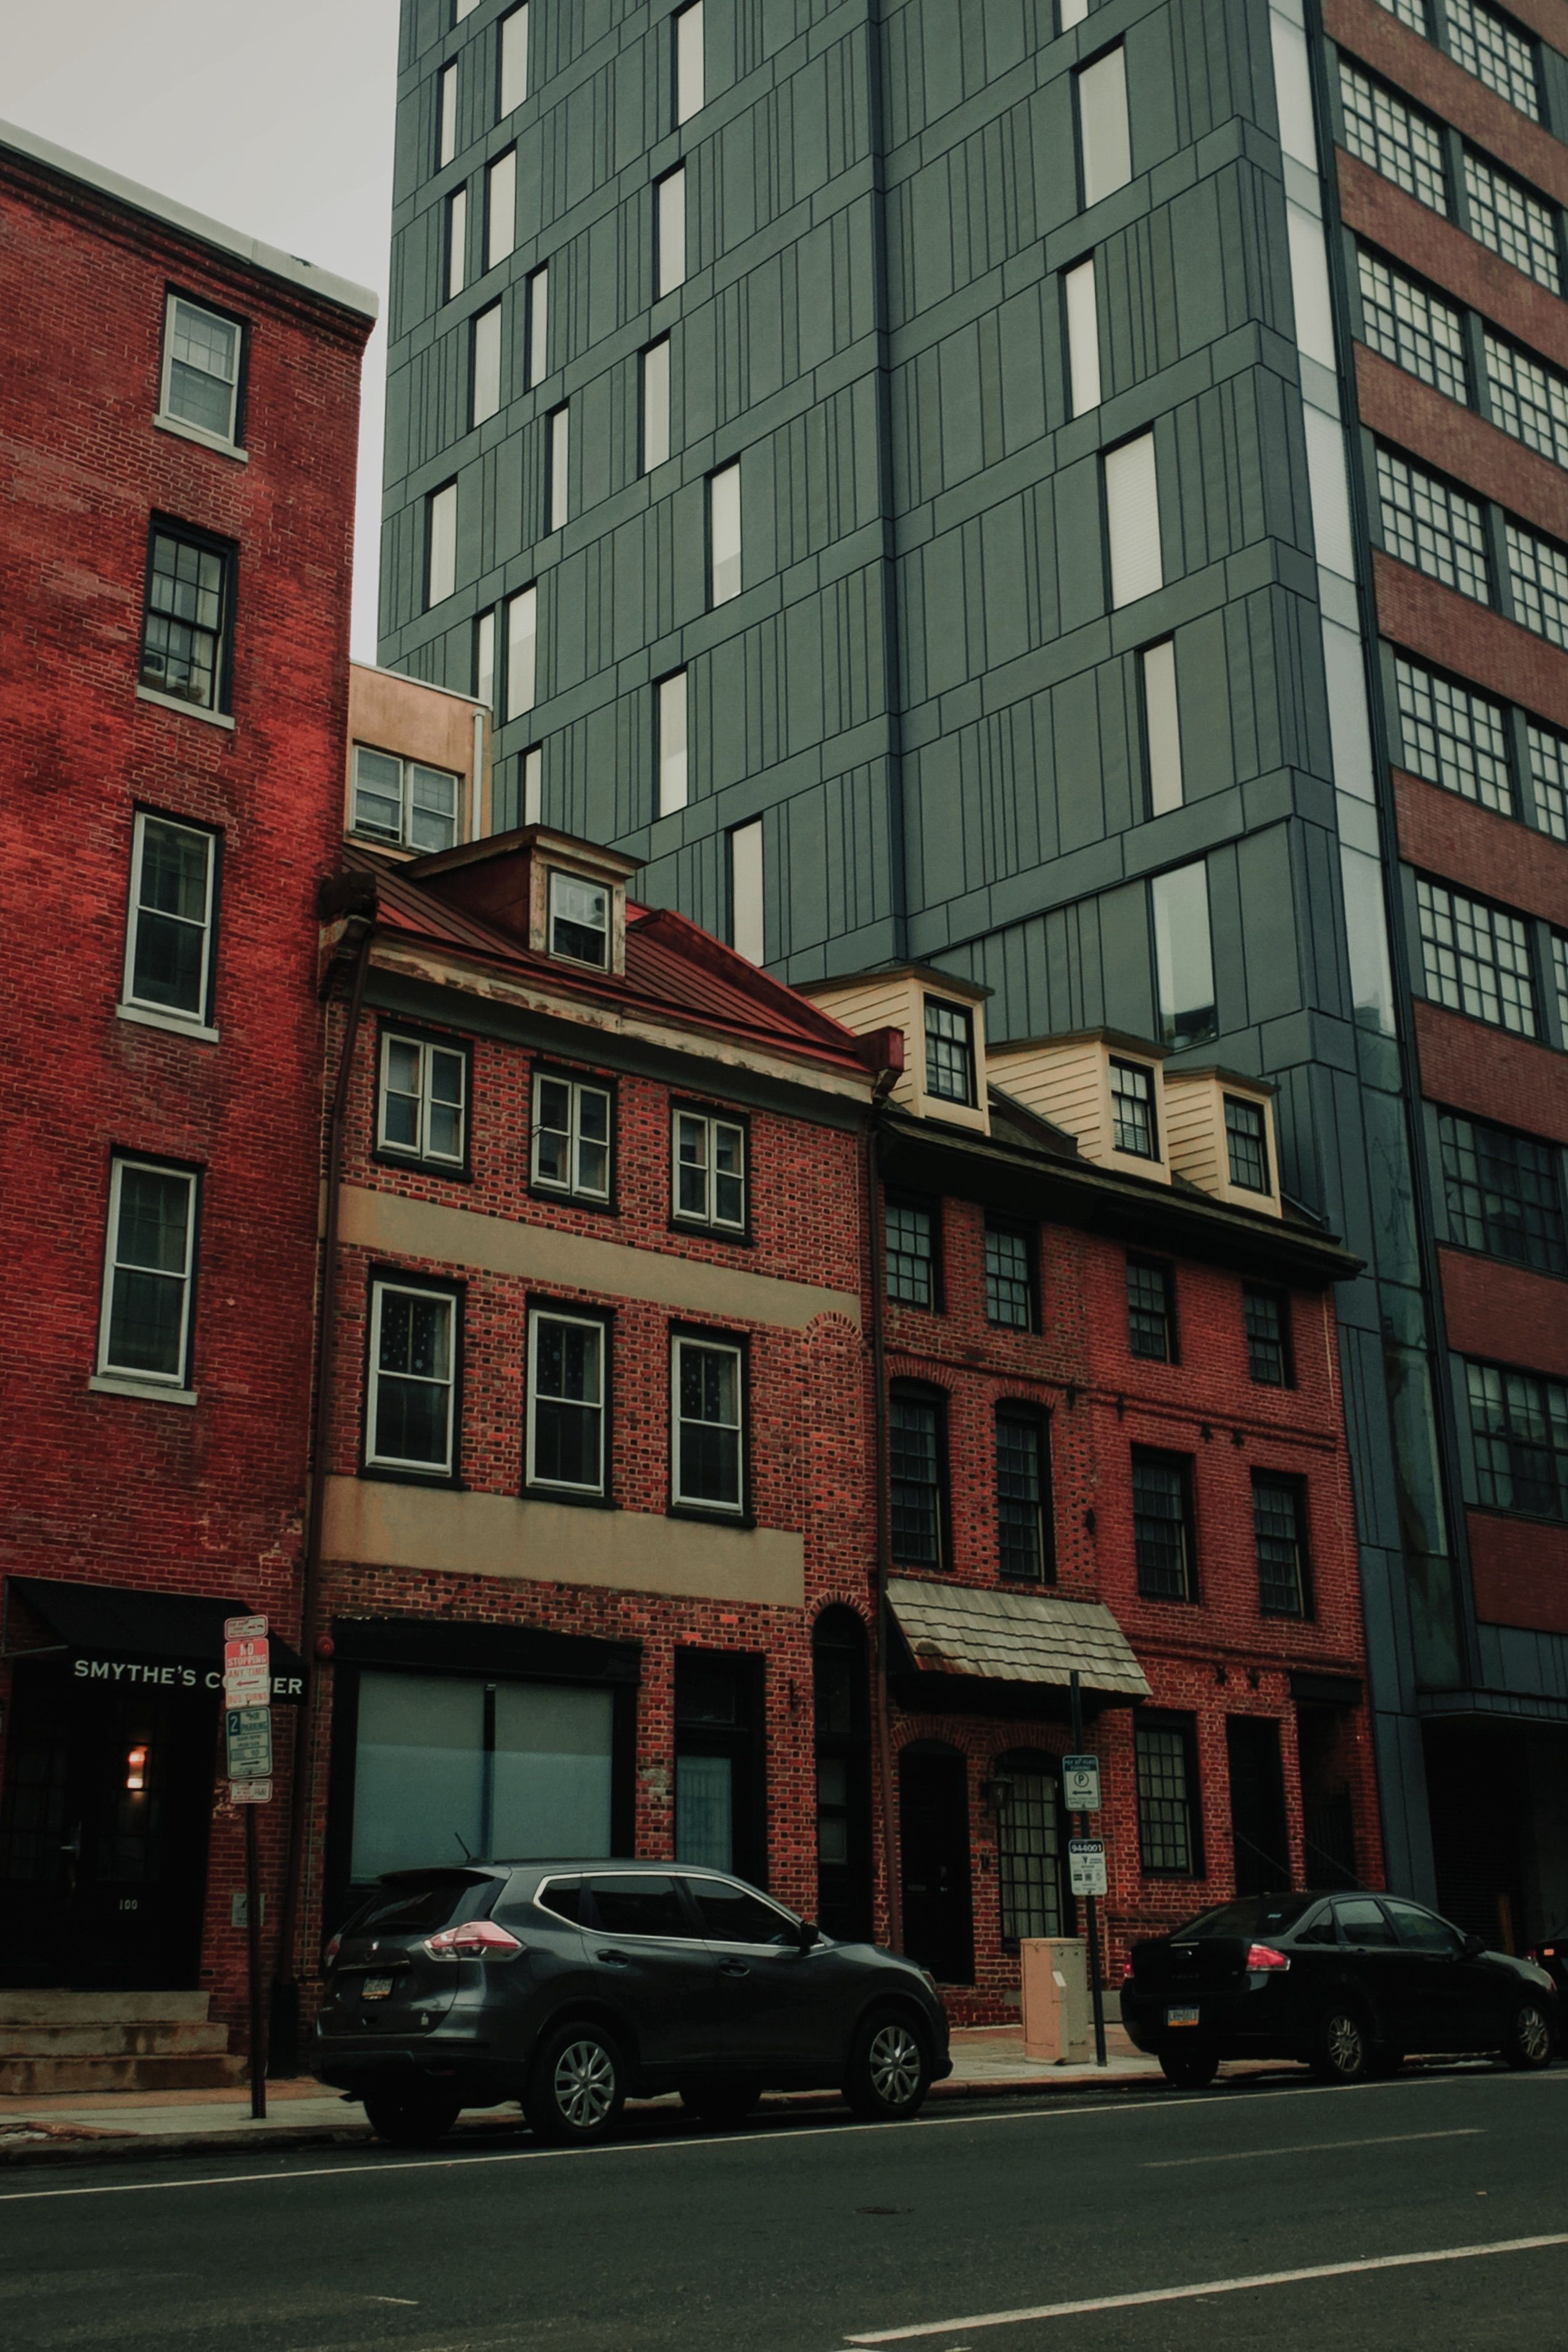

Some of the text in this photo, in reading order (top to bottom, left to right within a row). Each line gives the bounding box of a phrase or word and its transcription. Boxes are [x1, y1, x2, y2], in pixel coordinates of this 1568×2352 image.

[239, 1643, 254, 1656] NO
[228, 1654, 266, 1667] STOPPING
[73, 1659, 303, 1694] SMYTHE'S CER
[228, 1667, 267, 1678] ANY TIME
[229, 1715, 239, 1733] 2
[241, 1722, 267, 1732] PARKING
[1078, 1774, 1084, 1785] P
[1071, 1844, 1102, 1852] 944001
[119, 1899, 138, 1910] 100
